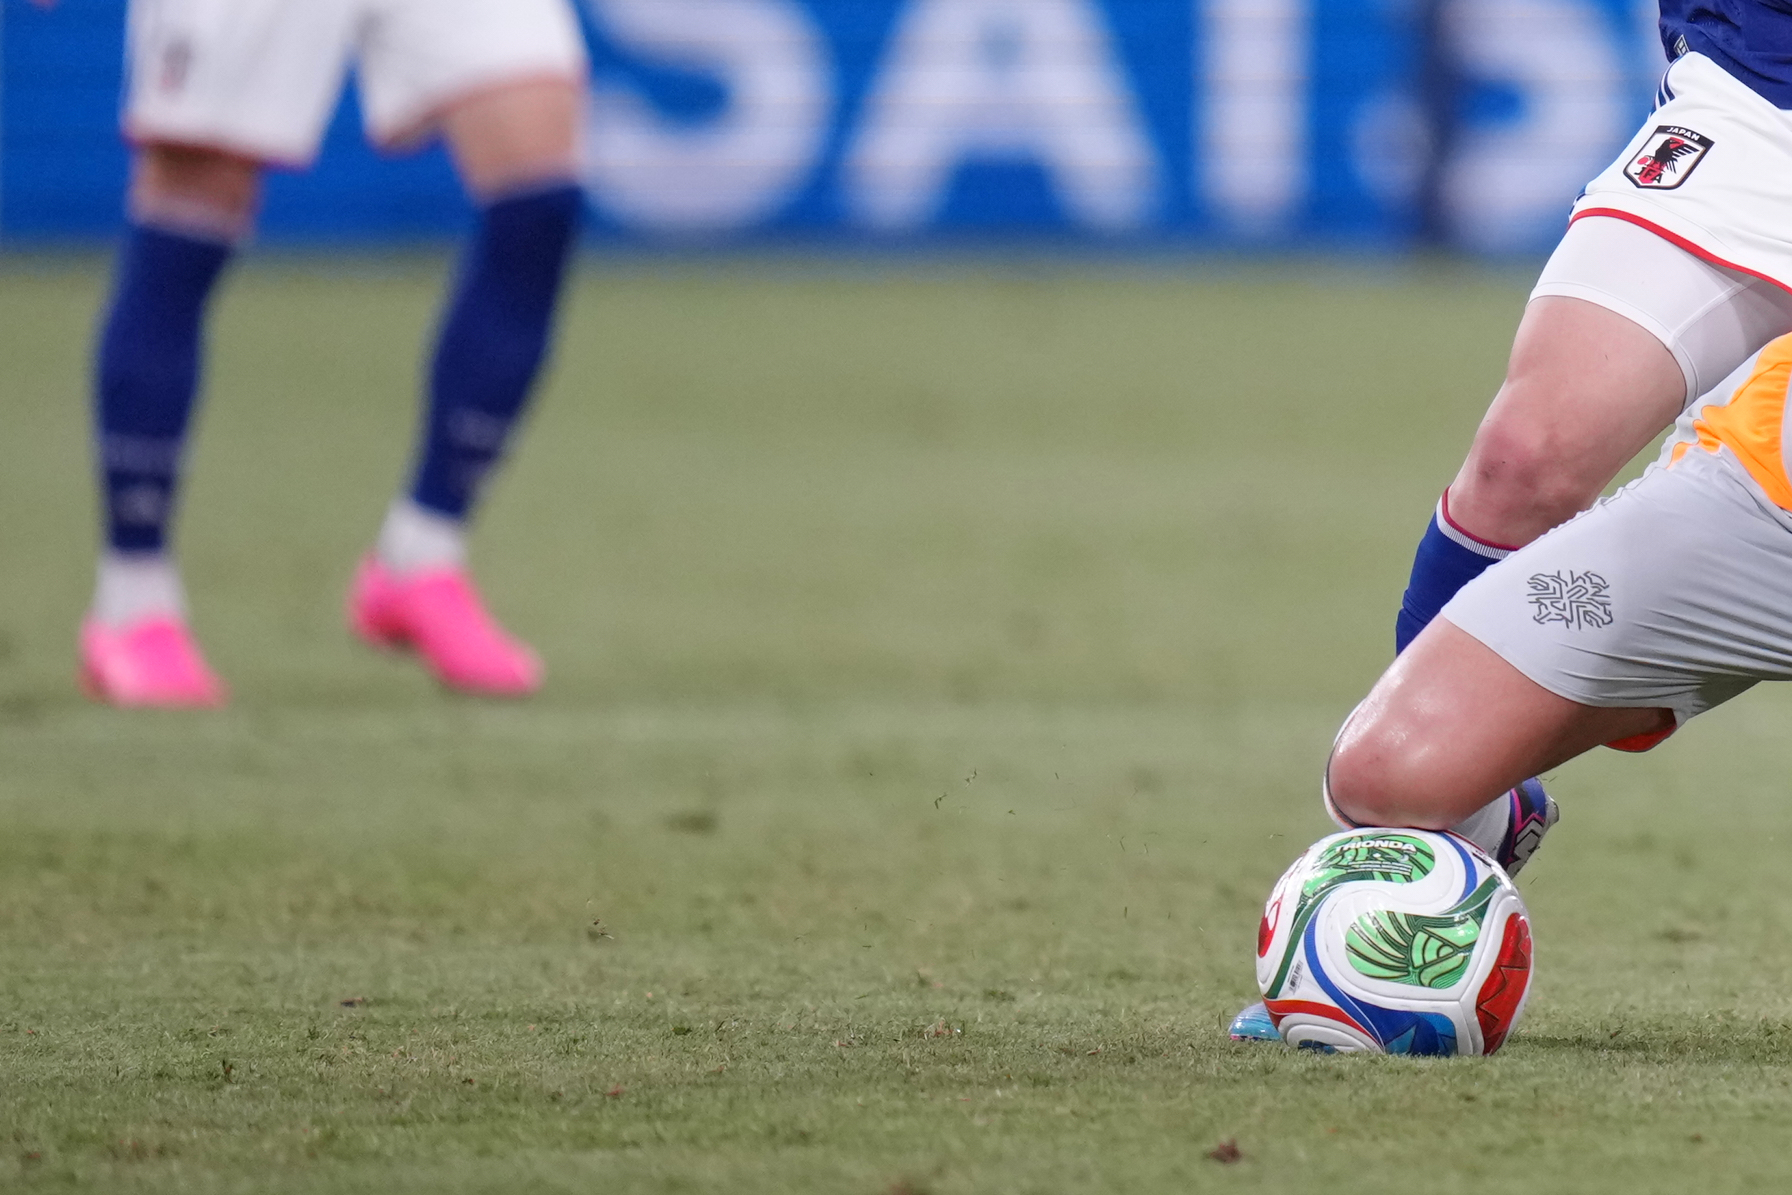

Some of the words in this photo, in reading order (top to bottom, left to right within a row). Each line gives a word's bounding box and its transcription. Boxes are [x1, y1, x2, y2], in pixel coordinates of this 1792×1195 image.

[1666, 126, 1700, 141] JAPAN
[1633, 166, 1663, 184] JFA
[1334, 838, 1418, 854] TRIONDA
